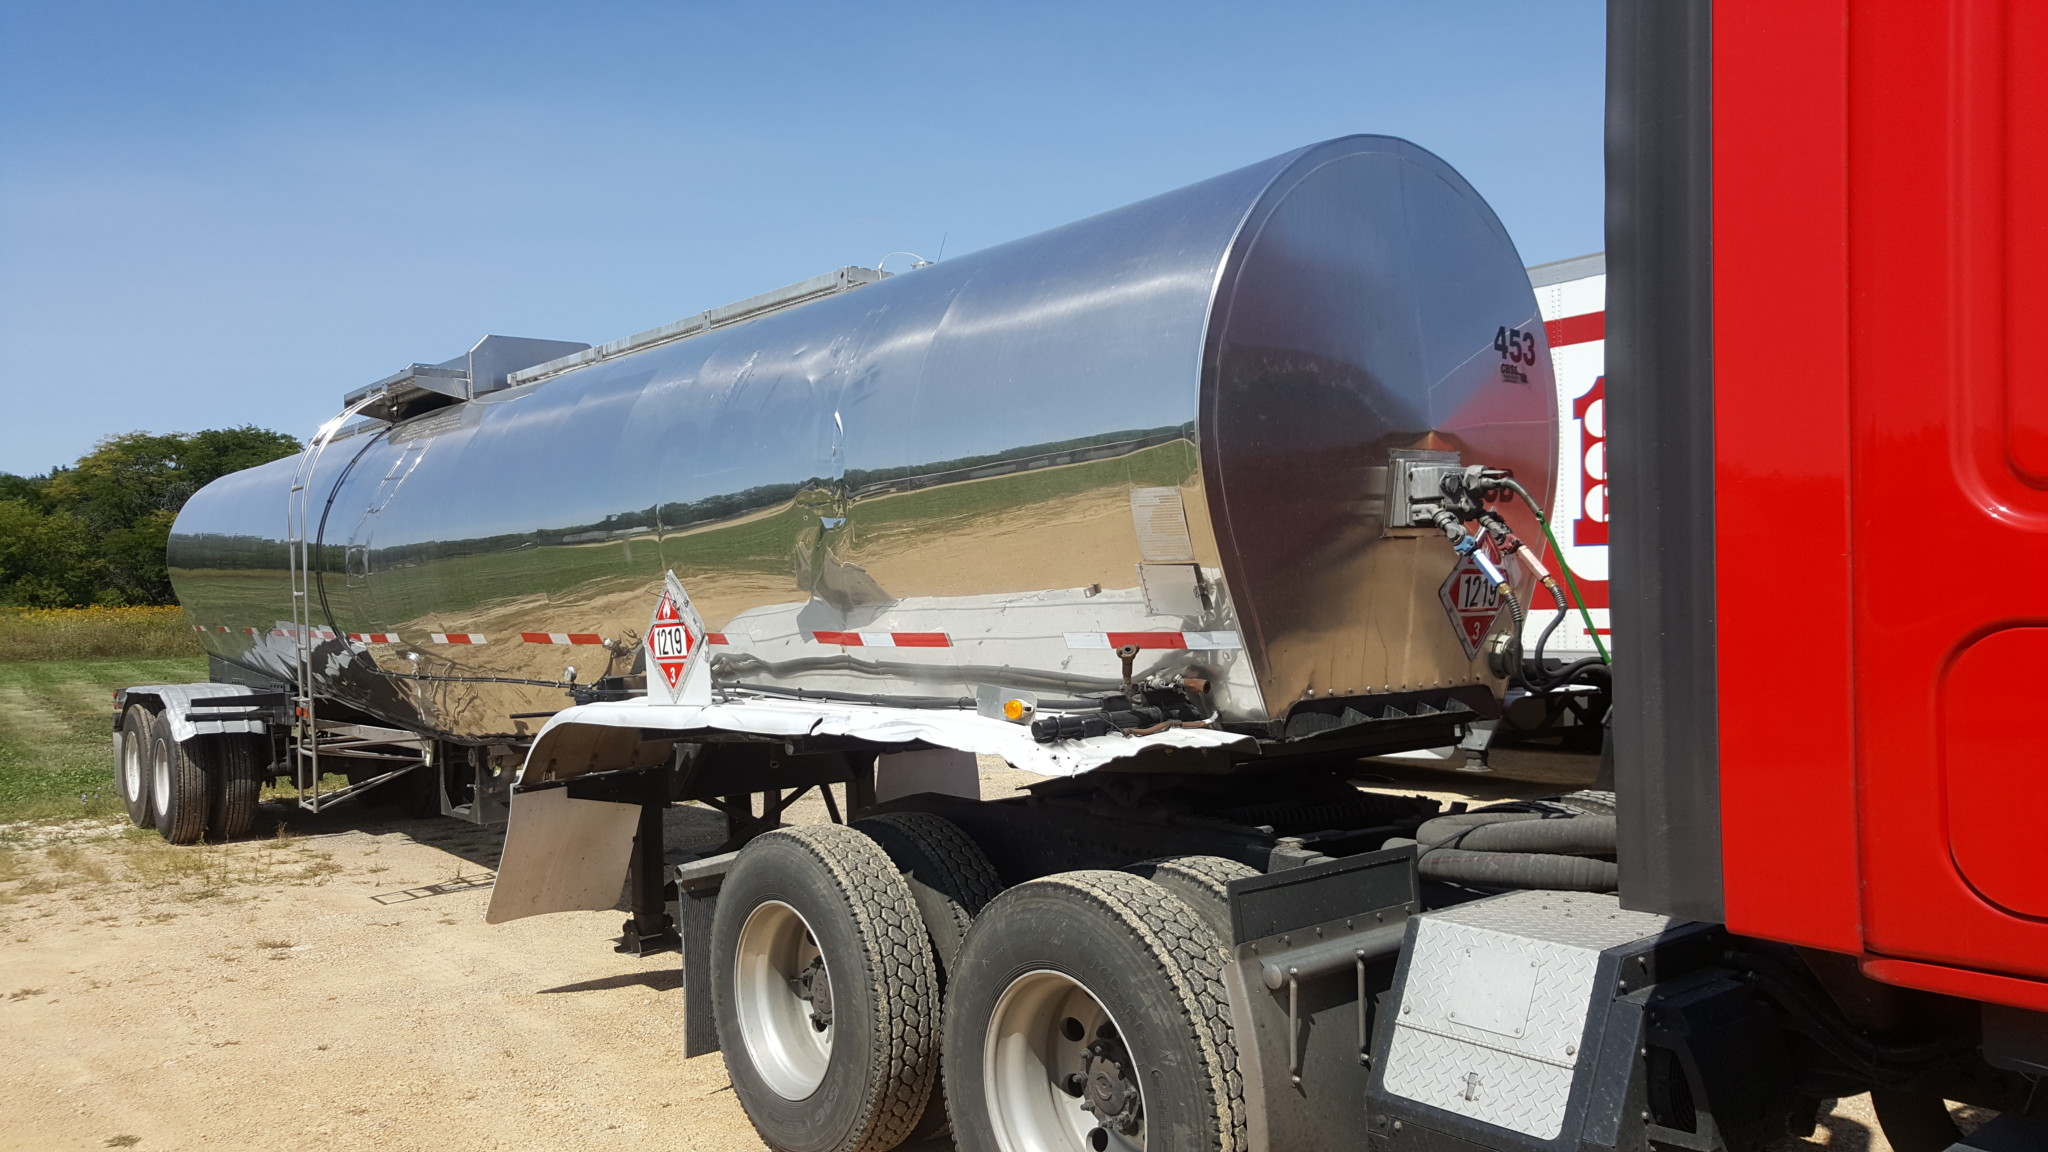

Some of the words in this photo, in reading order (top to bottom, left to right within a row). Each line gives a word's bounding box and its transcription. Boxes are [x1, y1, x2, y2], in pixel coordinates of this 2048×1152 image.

[1494, 326, 1536, 367] 453
[656, 627, 683, 656] 1219
[1472, 621, 1481, 640] 3
[670, 666, 677, 684] 3
